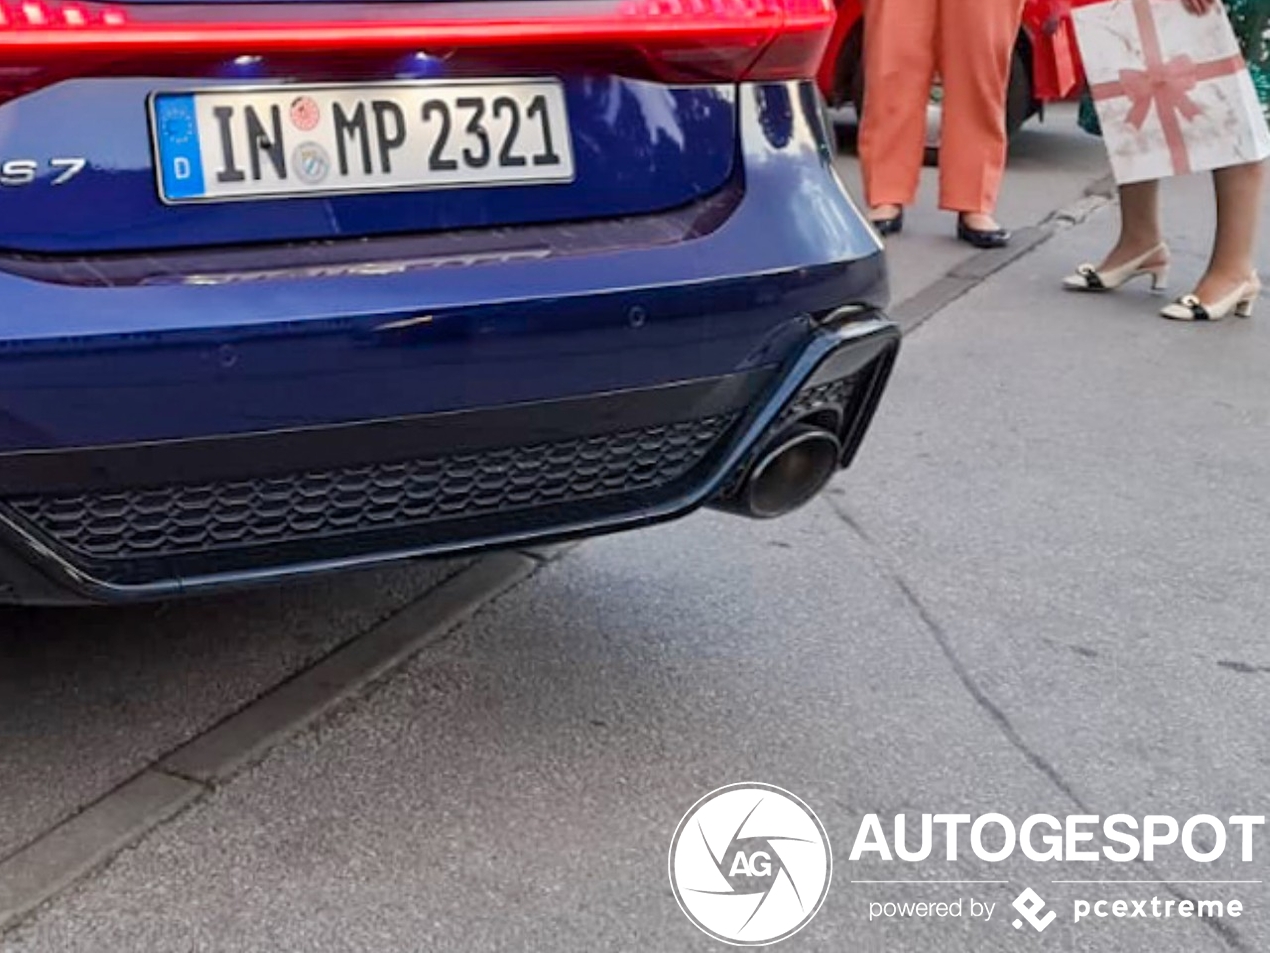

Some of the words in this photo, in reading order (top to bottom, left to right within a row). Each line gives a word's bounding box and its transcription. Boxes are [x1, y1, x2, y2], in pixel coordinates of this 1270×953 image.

[213, 104, 287, 182] IN
[332, 100, 406, 175] MP
[421, 95, 560, 170] 2321
[49, 158, 86, 185] 7
[174, 157, 190, 179] D
